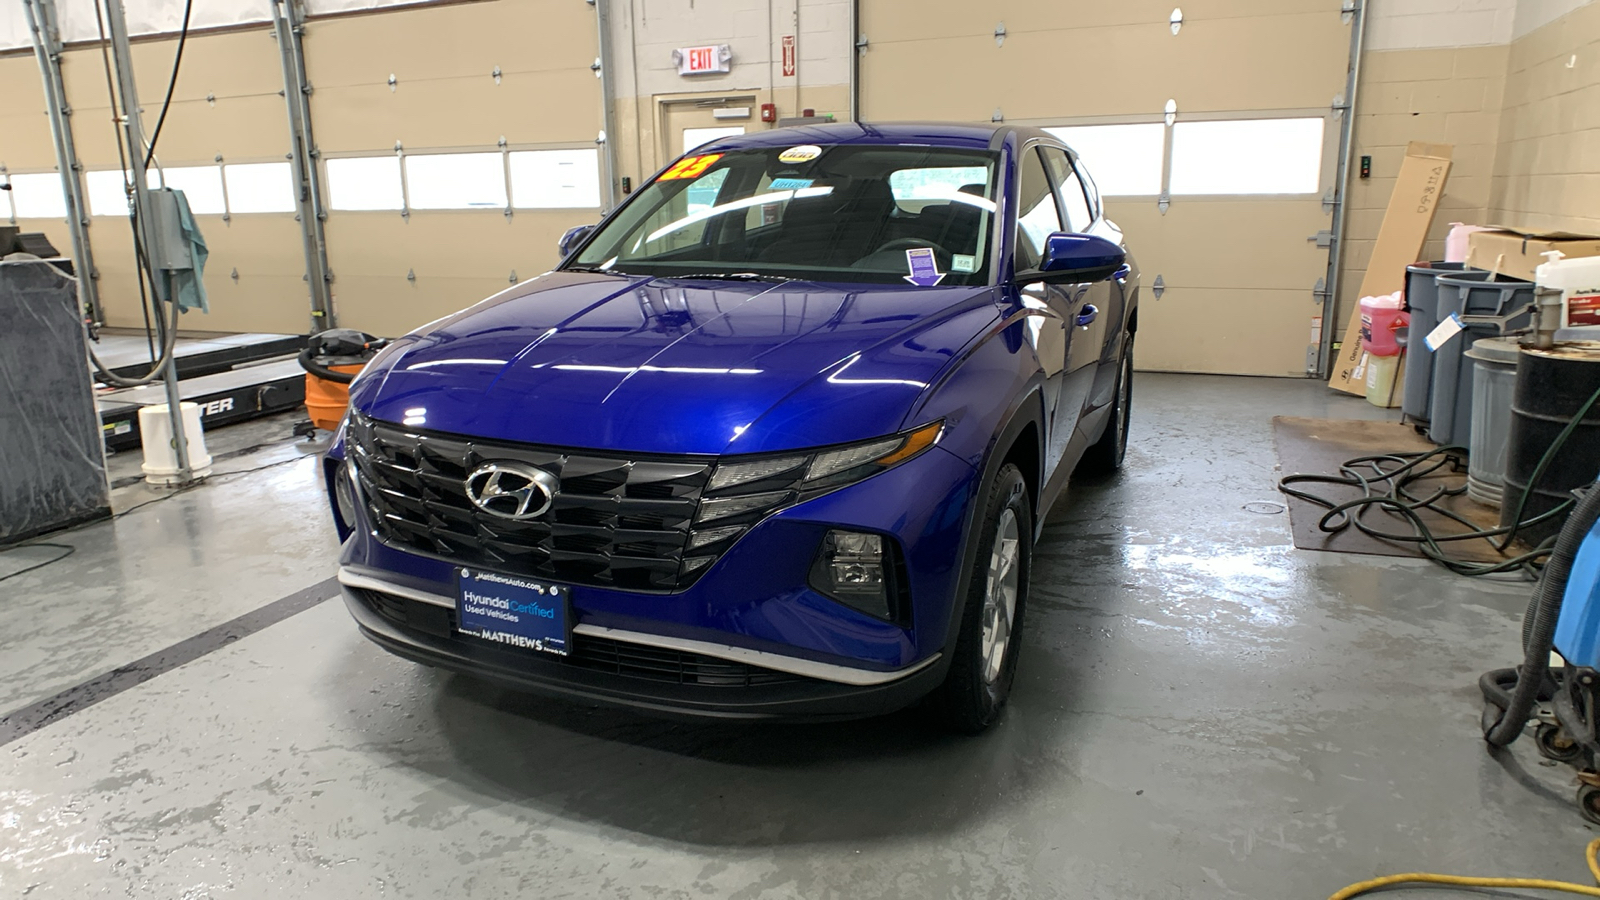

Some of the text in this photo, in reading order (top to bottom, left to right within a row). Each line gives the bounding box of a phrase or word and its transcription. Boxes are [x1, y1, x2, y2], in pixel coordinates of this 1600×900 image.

[689, 48, 713, 70] EXIT
[659, 154, 720, 181] 23
[463, 590, 554, 619] Hyundai Certified
[464, 603, 519, 623] Used Vehicles
[481, 628, 543, 651] MATTHEWS
